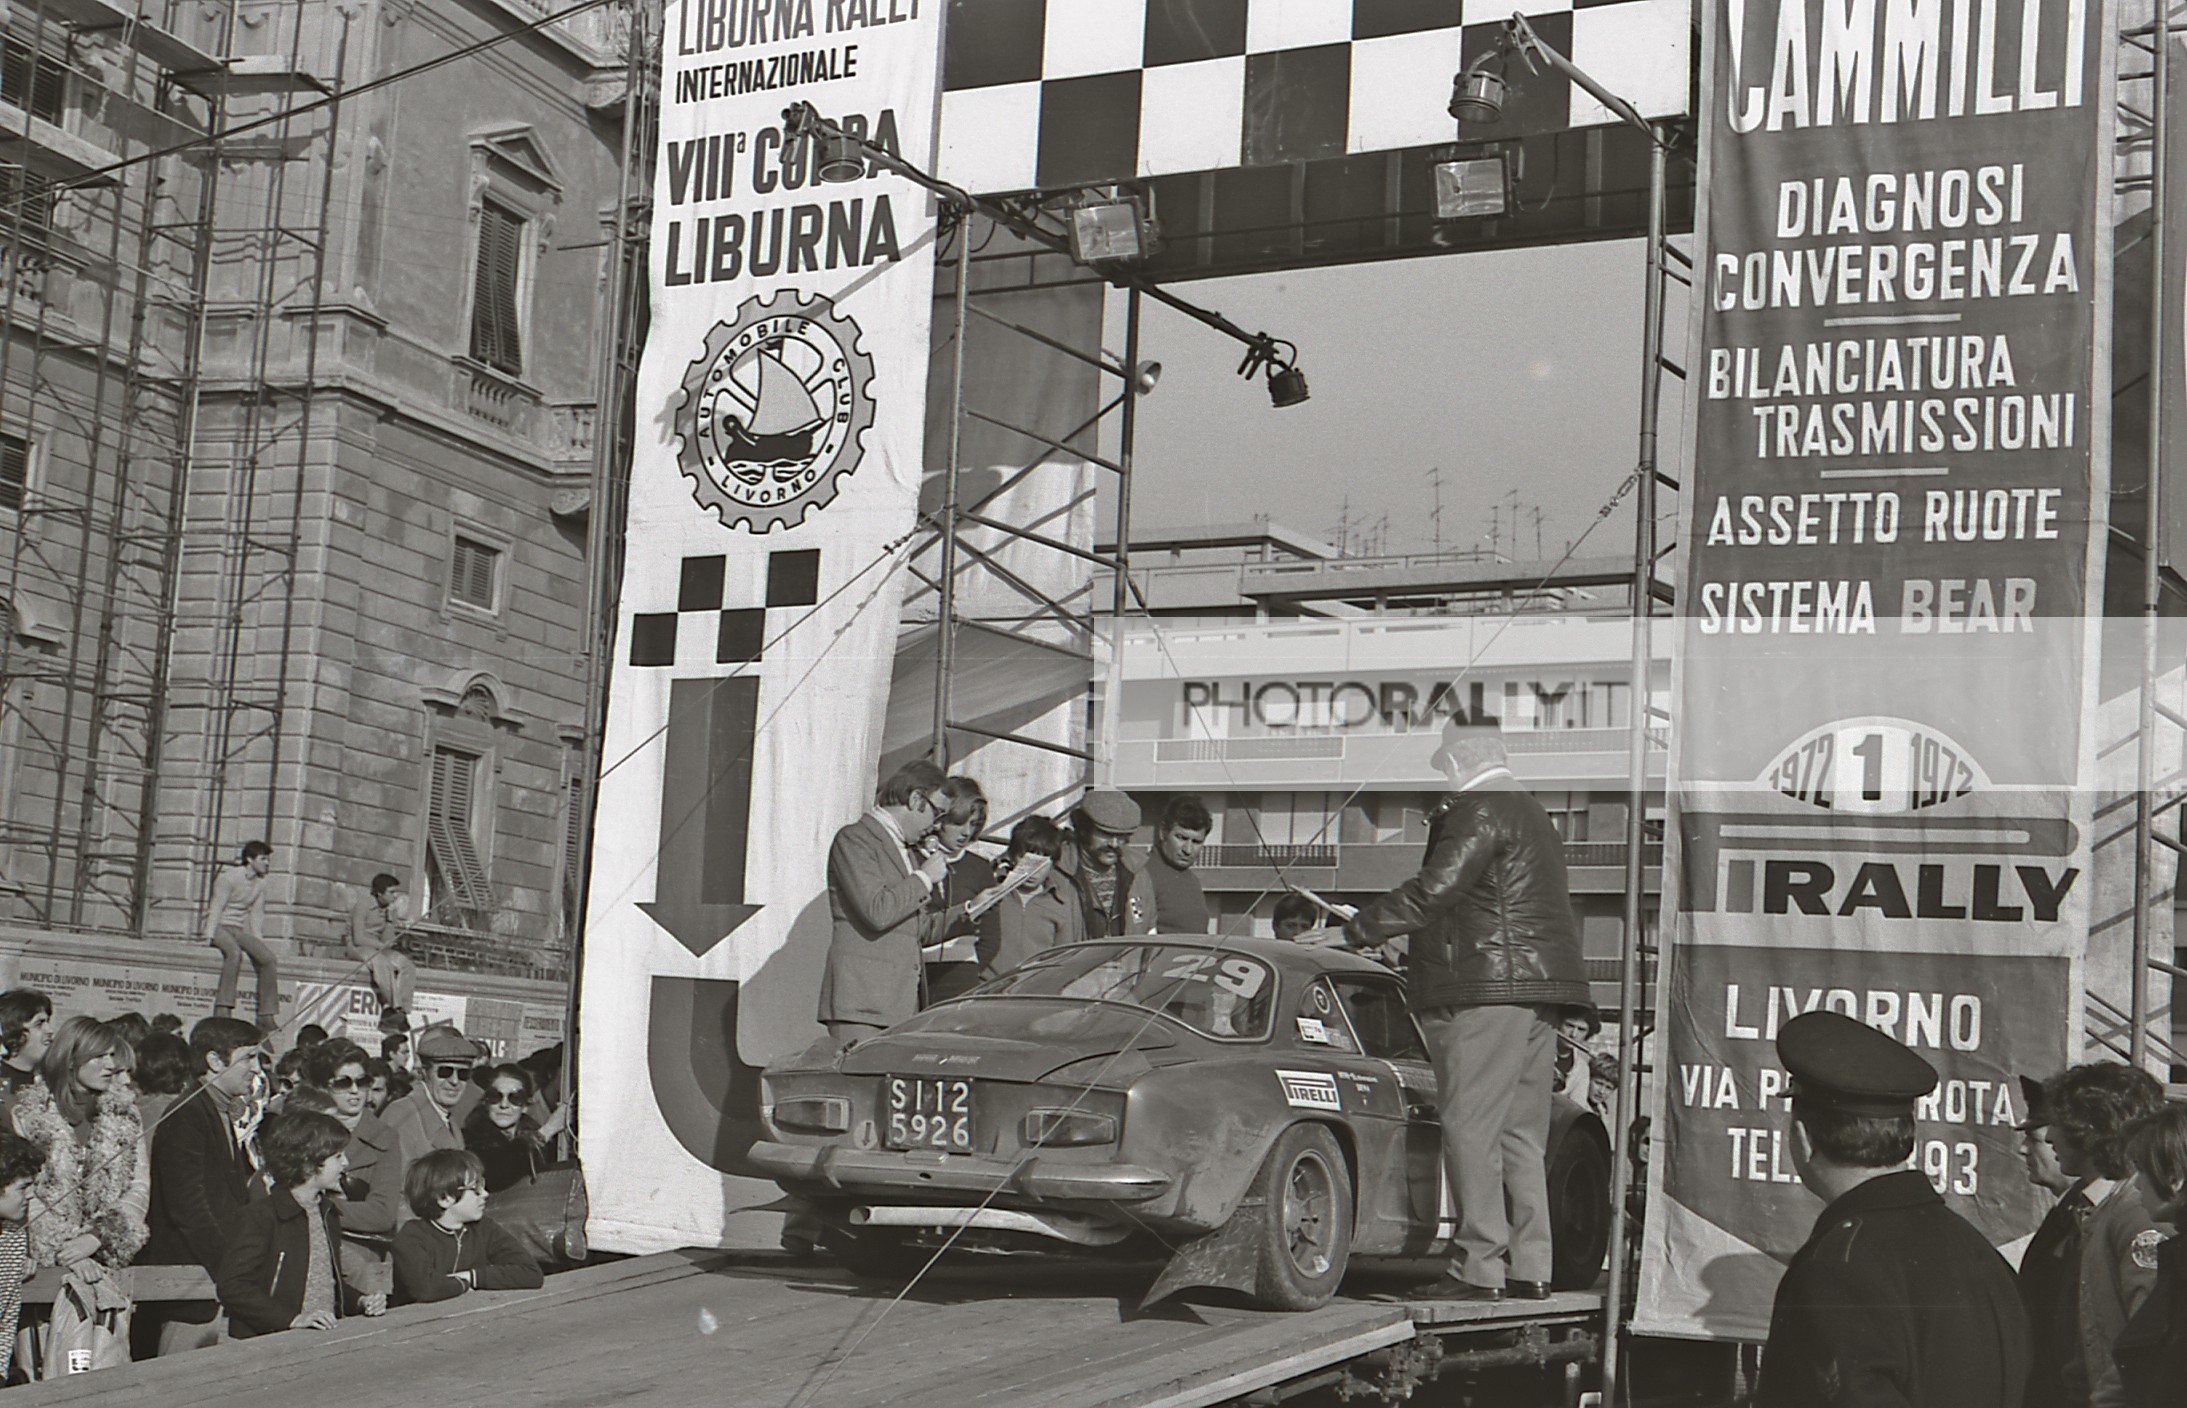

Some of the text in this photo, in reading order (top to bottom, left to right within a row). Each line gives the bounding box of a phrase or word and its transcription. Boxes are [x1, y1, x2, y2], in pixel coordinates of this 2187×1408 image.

[679, 0, 814, 56] LIBURNA
[676, 45, 858, 104] INTERNAZIONALE
[1777, 163, 2023, 238] DIAGNOSI
[665, 194, 901, 286] LIBURNA
[1713, 233, 2079, 311] CONVERGENZA
[699, 319, 851, 437] AUTOMOBILE CLUB
[1708, 334, 2016, 399] BILANCIATURA
[1753, 392, 2075, 458] TRASMISSIONI
[721, 469, 816, 503] LIVORNO
[1706, 488, 2062, 546] ASSETTO RUOTE
[1700, 577, 2037, 635] SISTEMA BEAR
[1769, 732, 1973, 810] 1972 1 1972
[1162, 954, 1266, 999] 29
[1281, 1076, 1338, 1103] PIRELLI
[1680, 1064, 1739, 1110] VIA
[892, 1113, 969, 1147] 5926
[1727, 1128, 1802, 1184] TEL.
